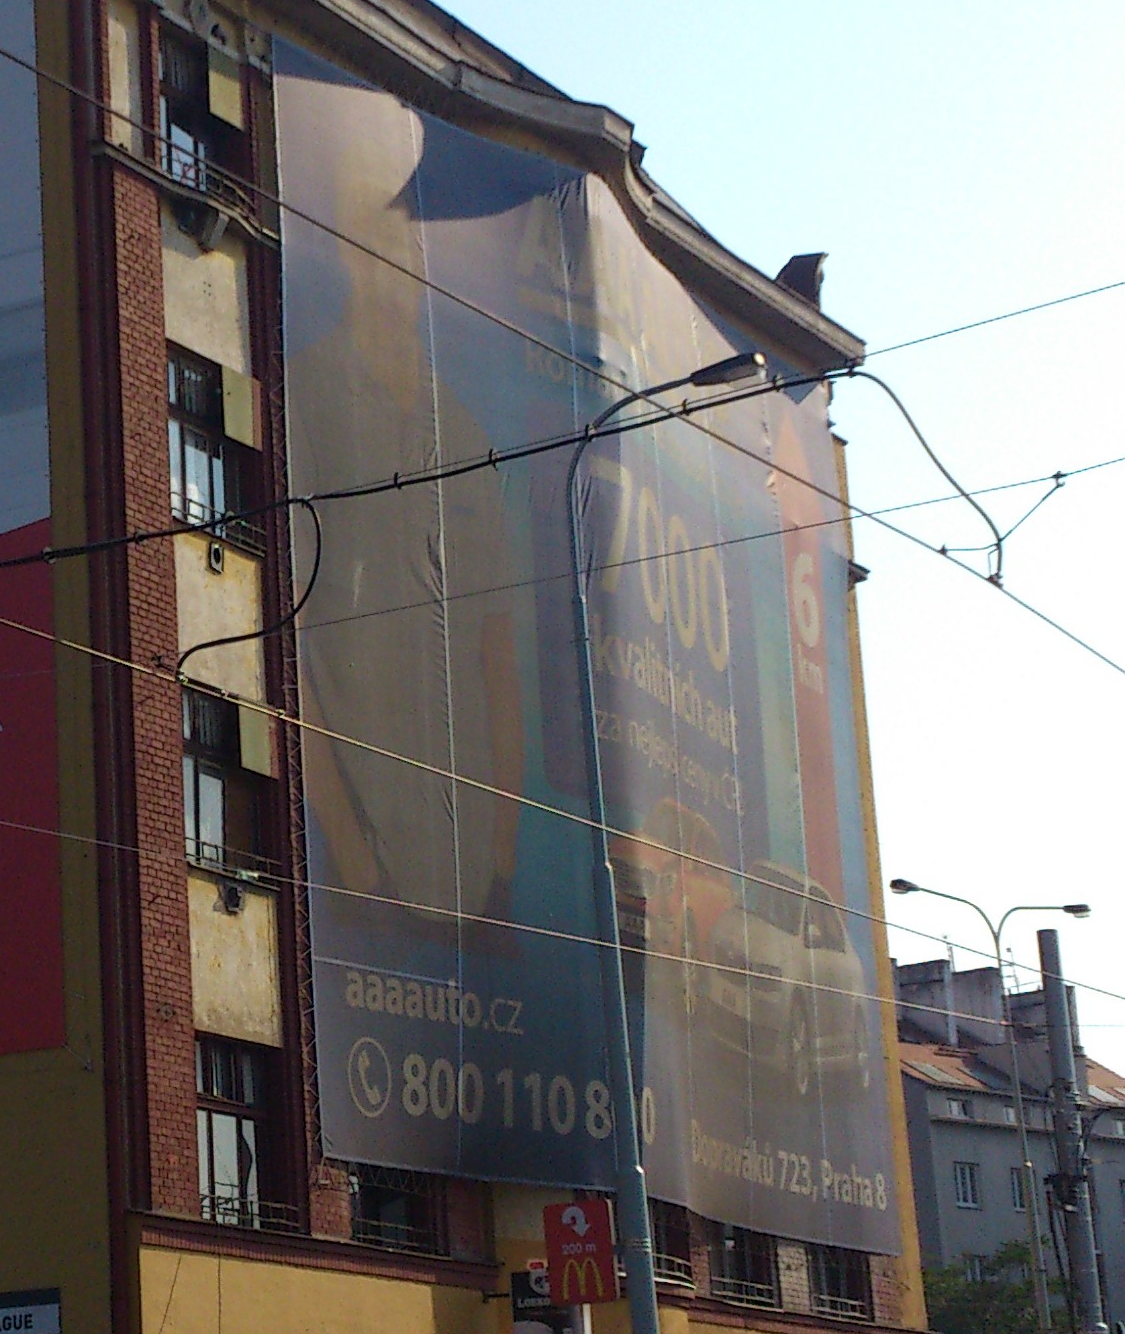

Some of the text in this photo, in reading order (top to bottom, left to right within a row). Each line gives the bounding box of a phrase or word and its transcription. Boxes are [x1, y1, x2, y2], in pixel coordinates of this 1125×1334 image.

[589, 454, 731, 673] 7000
[792, 552, 821, 648] 6
[344, 970, 524, 1036] aaaauto.cz
[401, 1053, 656, 1145] 800 110 80
[778, 1150, 818, 1203] 723,
[821, 1158, 874, 1209] Praha
[875, 1172, 888, 1212] 8
[562, 1242, 583, 1255] 200
